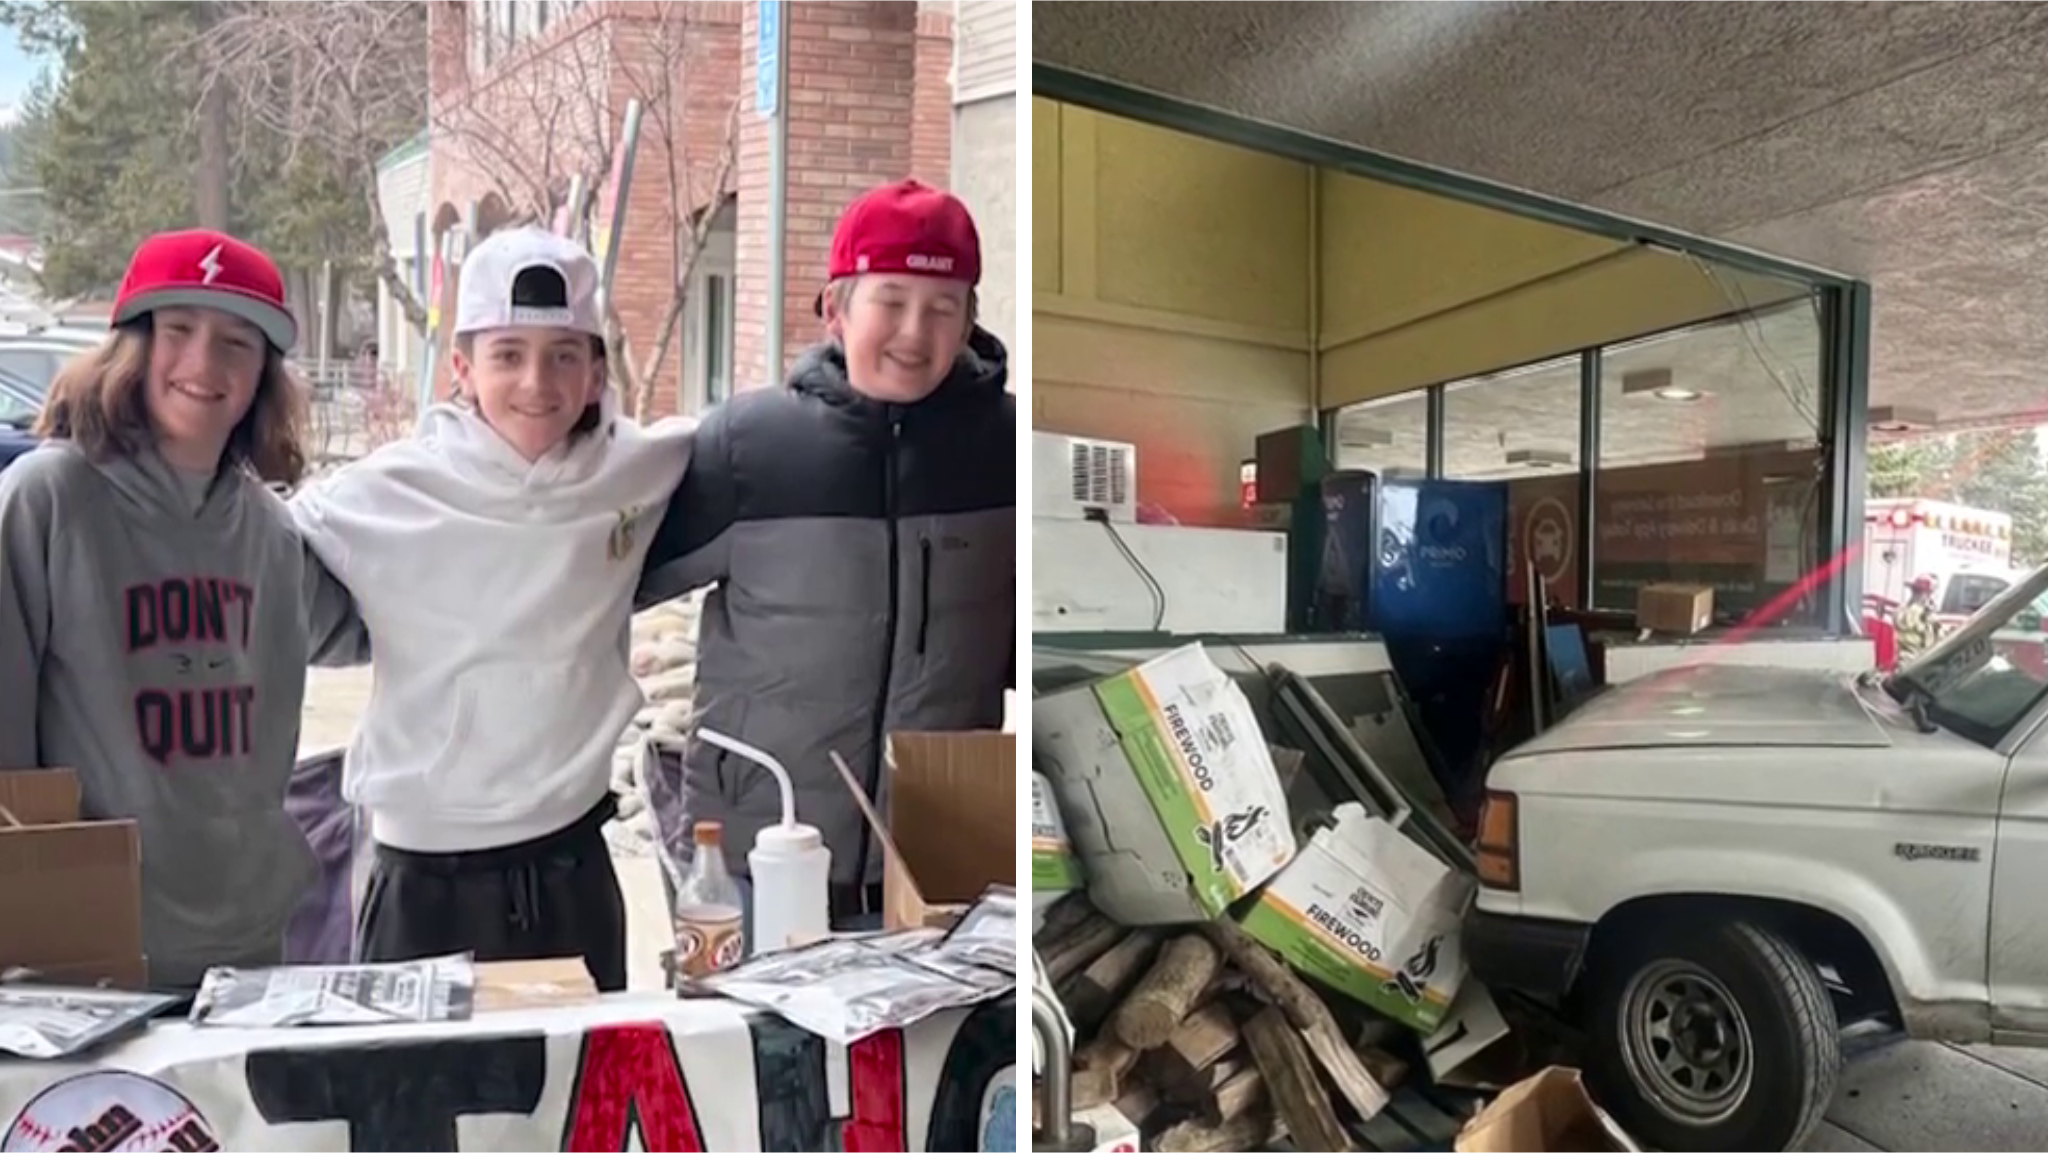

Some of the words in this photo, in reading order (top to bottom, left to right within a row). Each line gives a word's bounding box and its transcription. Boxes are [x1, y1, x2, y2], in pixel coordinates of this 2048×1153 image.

[906, 253, 954, 271] GRANT
[1420, 546, 1467, 561] PRIMO
[1942, 534, 1992, 554] TRUCKEE
[124, 577, 254, 655] DON'T
[134, 686, 254, 766] QUIT
[1164, 704, 1214, 792] FIREWOOD
[1306, 904, 1382, 962] FIREWOOD
